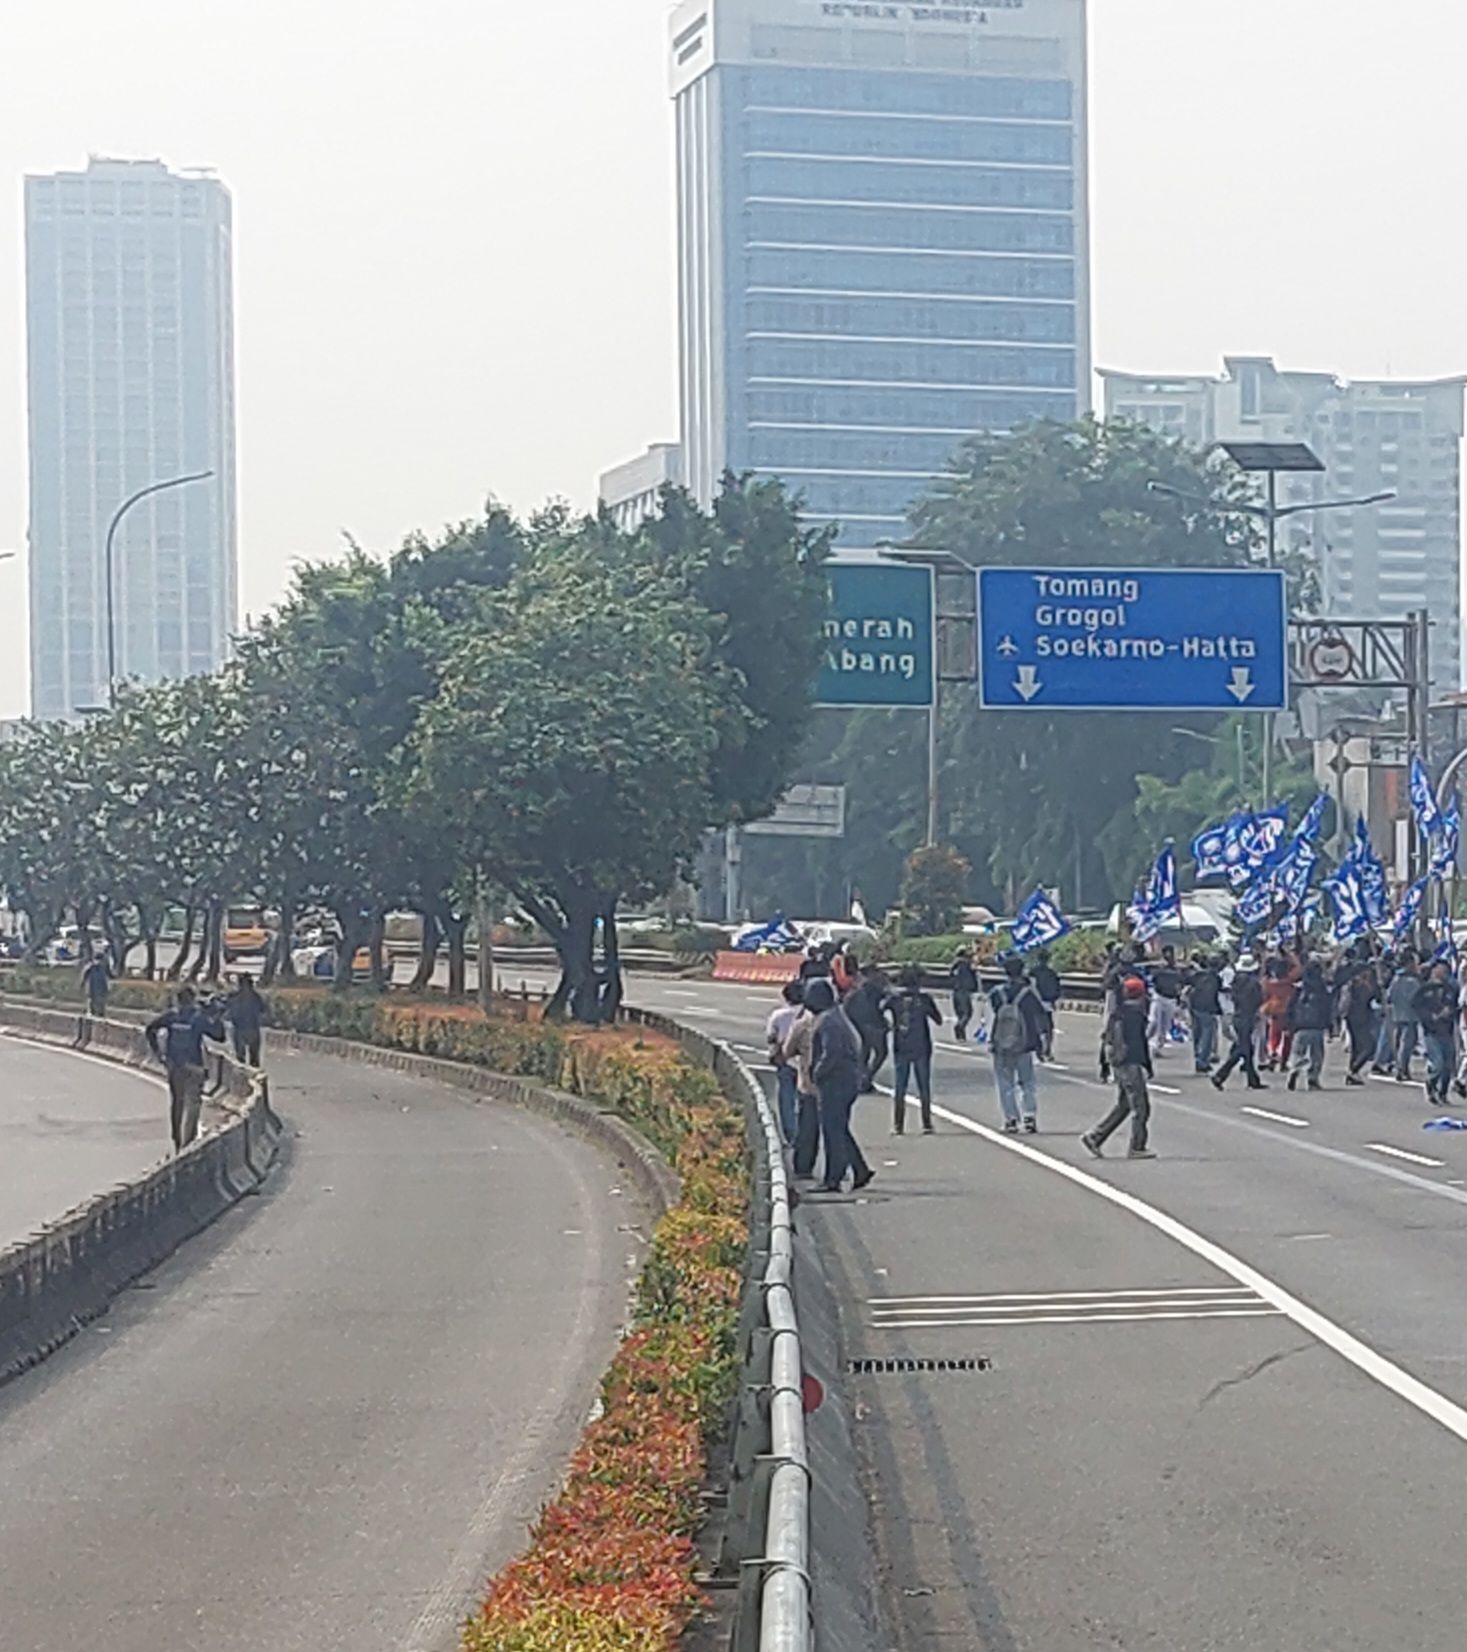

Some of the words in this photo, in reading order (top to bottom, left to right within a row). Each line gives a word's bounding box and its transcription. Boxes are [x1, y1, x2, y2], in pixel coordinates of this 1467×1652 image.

[1033, 575, 1139, 602] Tomang
[1035, 604, 1126, 631] Grogol
[1035, 634, 1256, 661] Soekarno-Hatta
